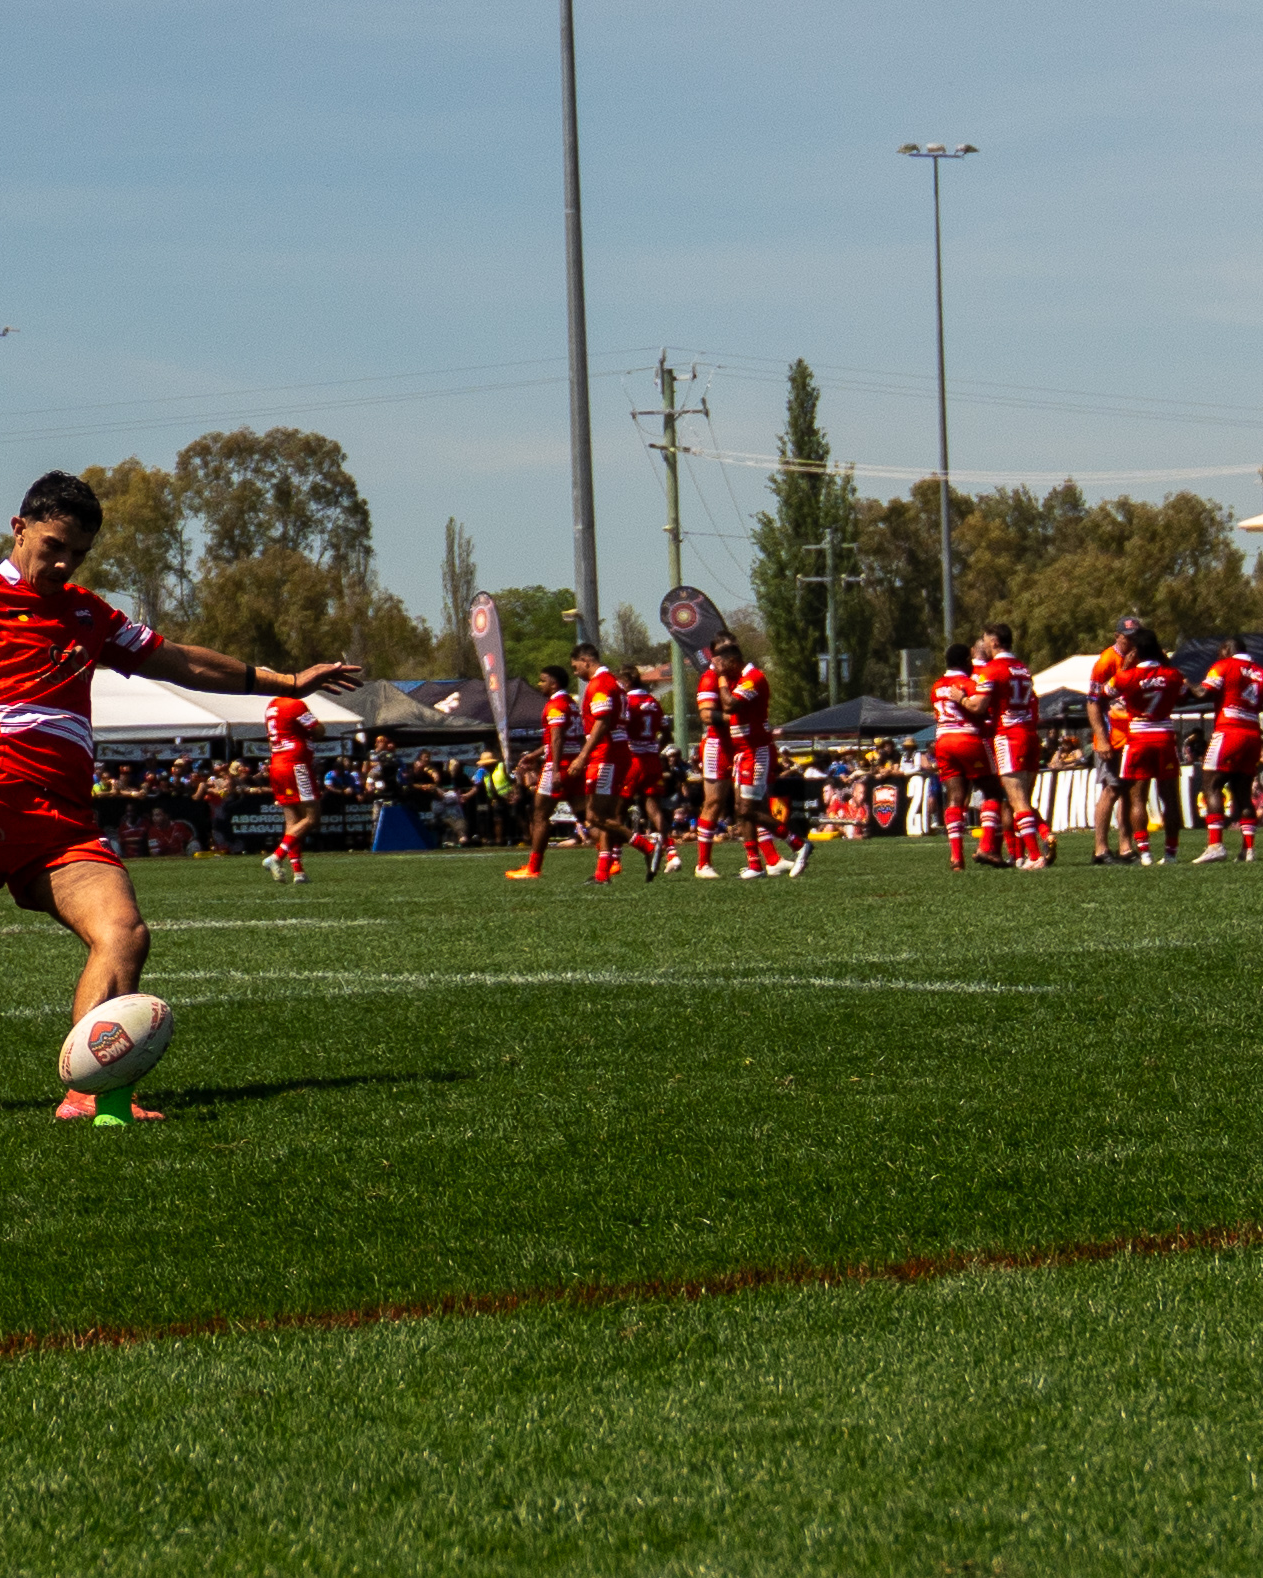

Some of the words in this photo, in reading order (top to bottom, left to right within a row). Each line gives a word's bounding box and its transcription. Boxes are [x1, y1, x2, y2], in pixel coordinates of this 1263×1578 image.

[1009, 680, 1032, 705] 17
[1143, 691, 1162, 715] 7
[1241, 682, 1258, 705] 4
[641, 715, 652, 737] 1
